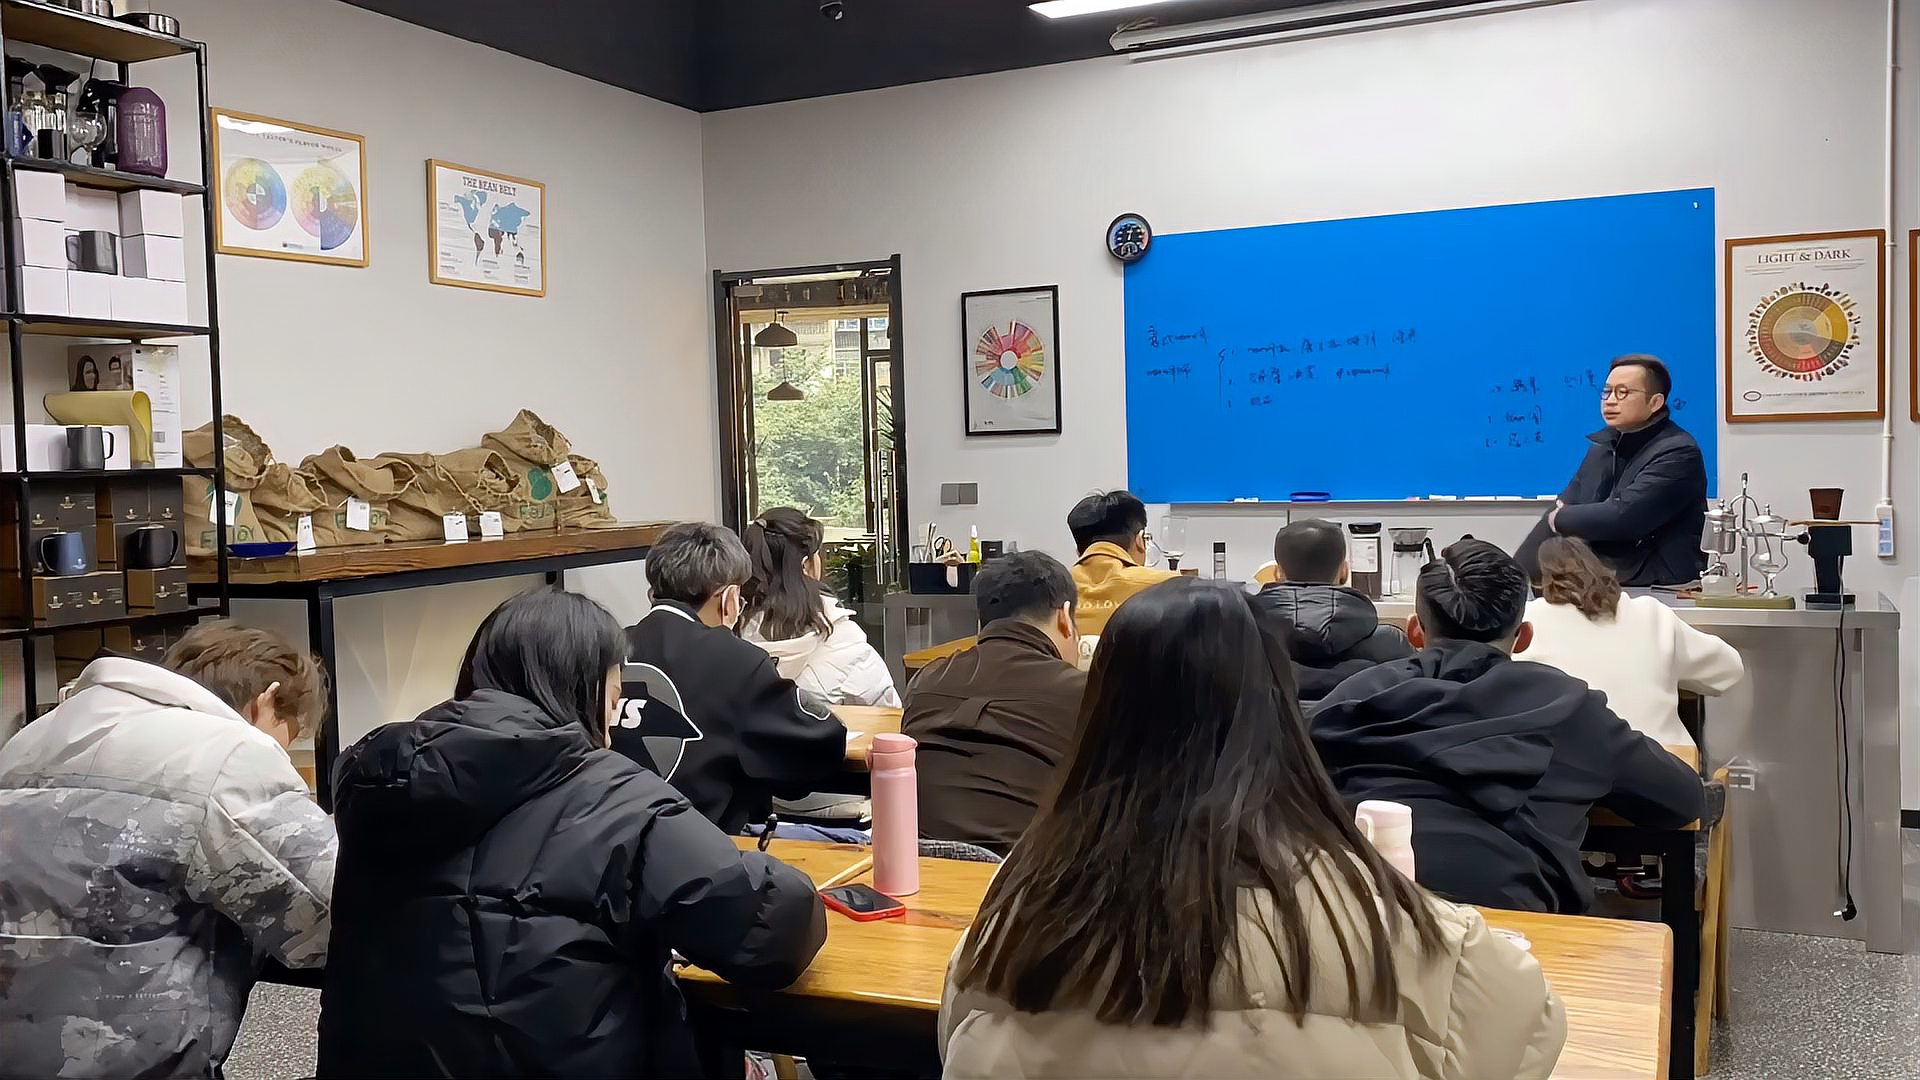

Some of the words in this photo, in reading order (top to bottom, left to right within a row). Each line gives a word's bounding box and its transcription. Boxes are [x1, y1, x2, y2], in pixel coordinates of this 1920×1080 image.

[462, 175, 478, 189] THE
[478, 179, 498, 193] BEAN
[499, 184, 517, 197] BELT
[1757, 252, 1795, 265] LIGHT
[1798, 252, 1811, 262] &
[1814, 248, 1852, 261] DARK
